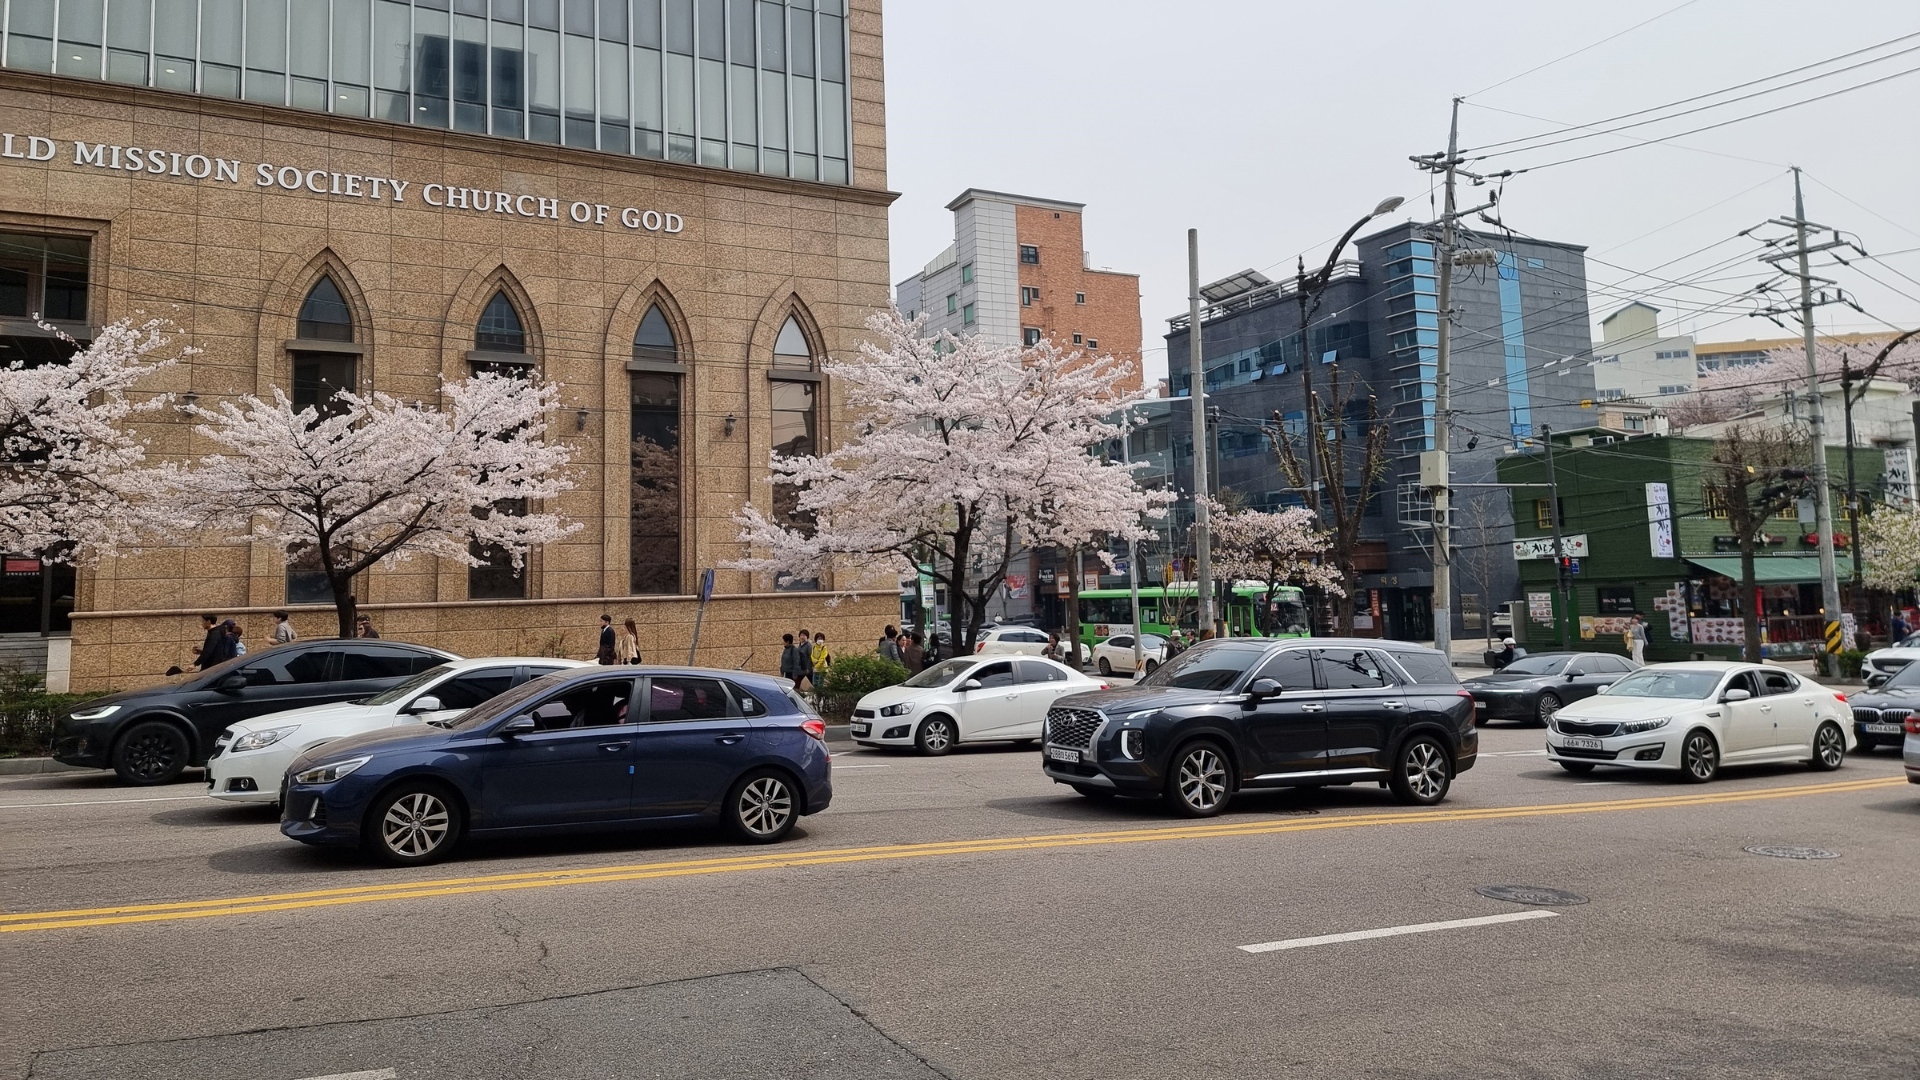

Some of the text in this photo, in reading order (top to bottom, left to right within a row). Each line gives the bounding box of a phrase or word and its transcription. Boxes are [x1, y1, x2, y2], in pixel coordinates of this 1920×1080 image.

[1, 133, 685, 234] LD MISSION SOCIETY CHURCH OF GOD
